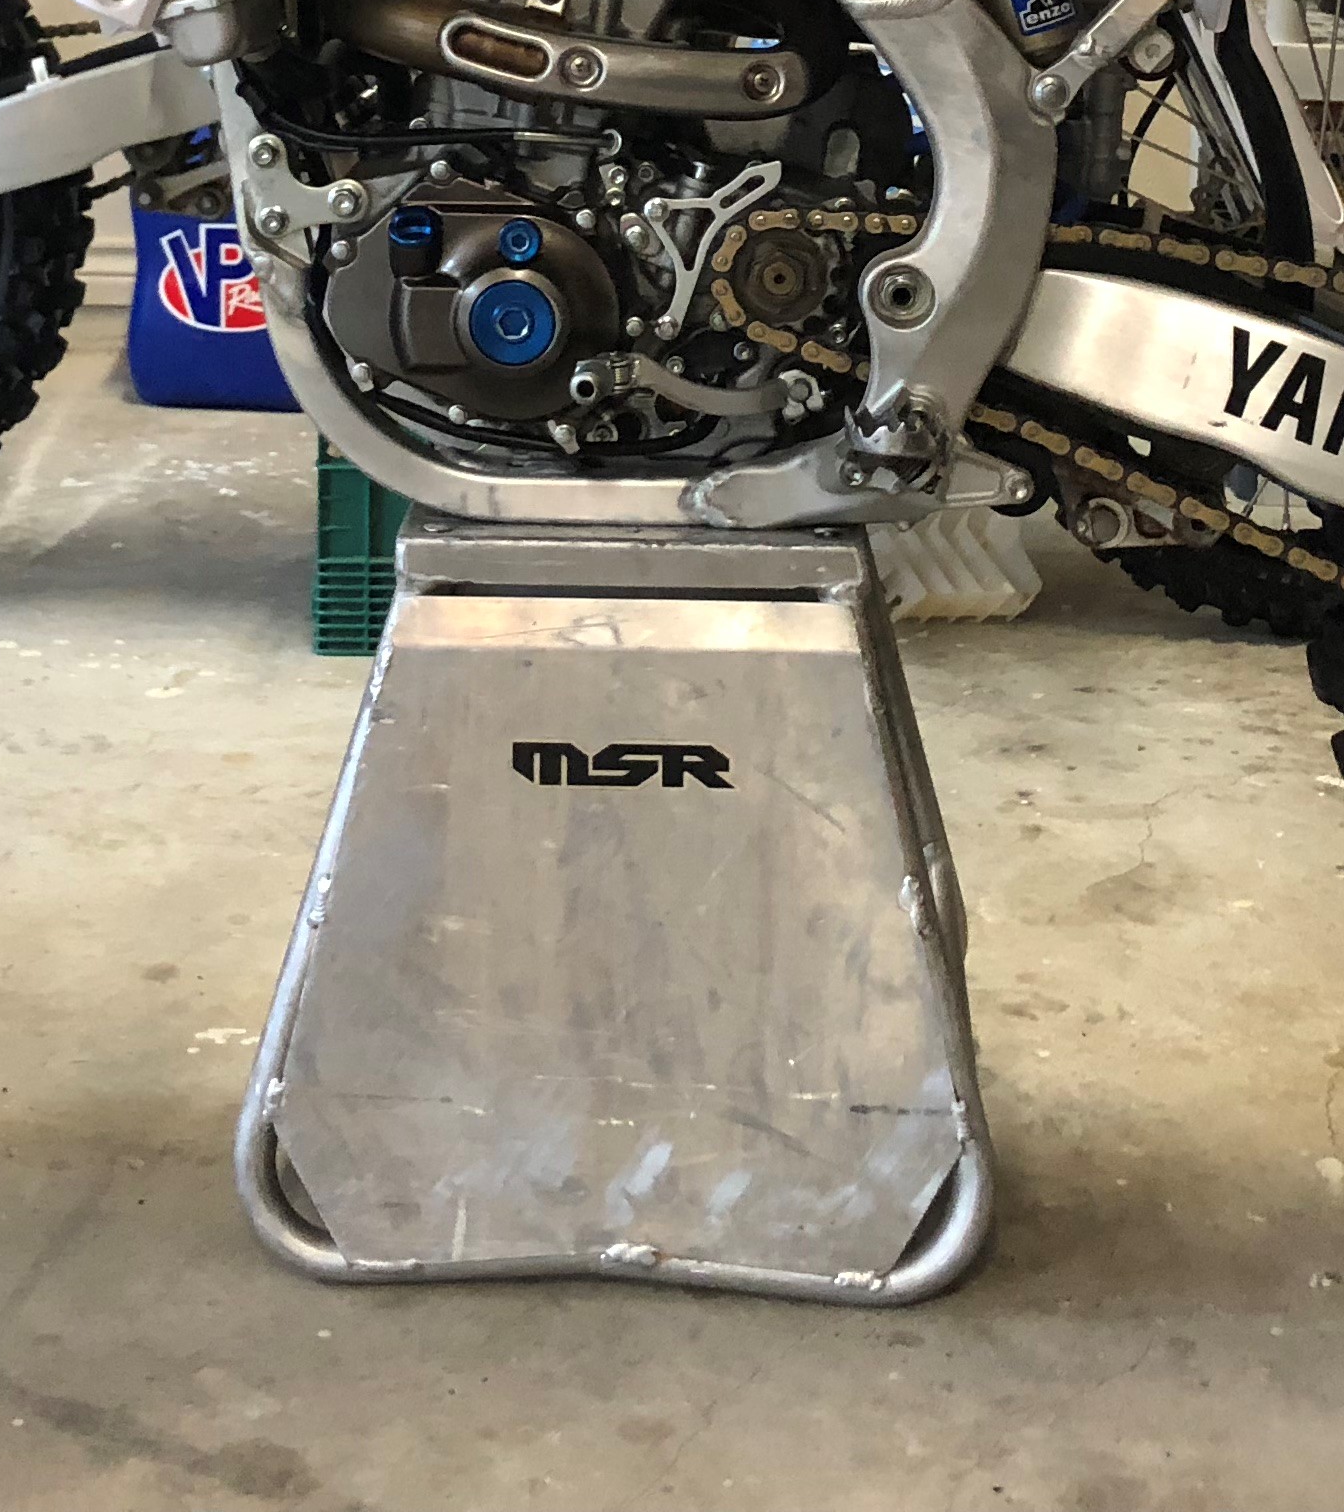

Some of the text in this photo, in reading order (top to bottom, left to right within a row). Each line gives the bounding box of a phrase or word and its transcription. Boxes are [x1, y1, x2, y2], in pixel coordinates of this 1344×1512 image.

[1026, 2, 1071, 25] enzo
[159, 223, 258, 329] VP
[512, 741, 736, 789] MSR
